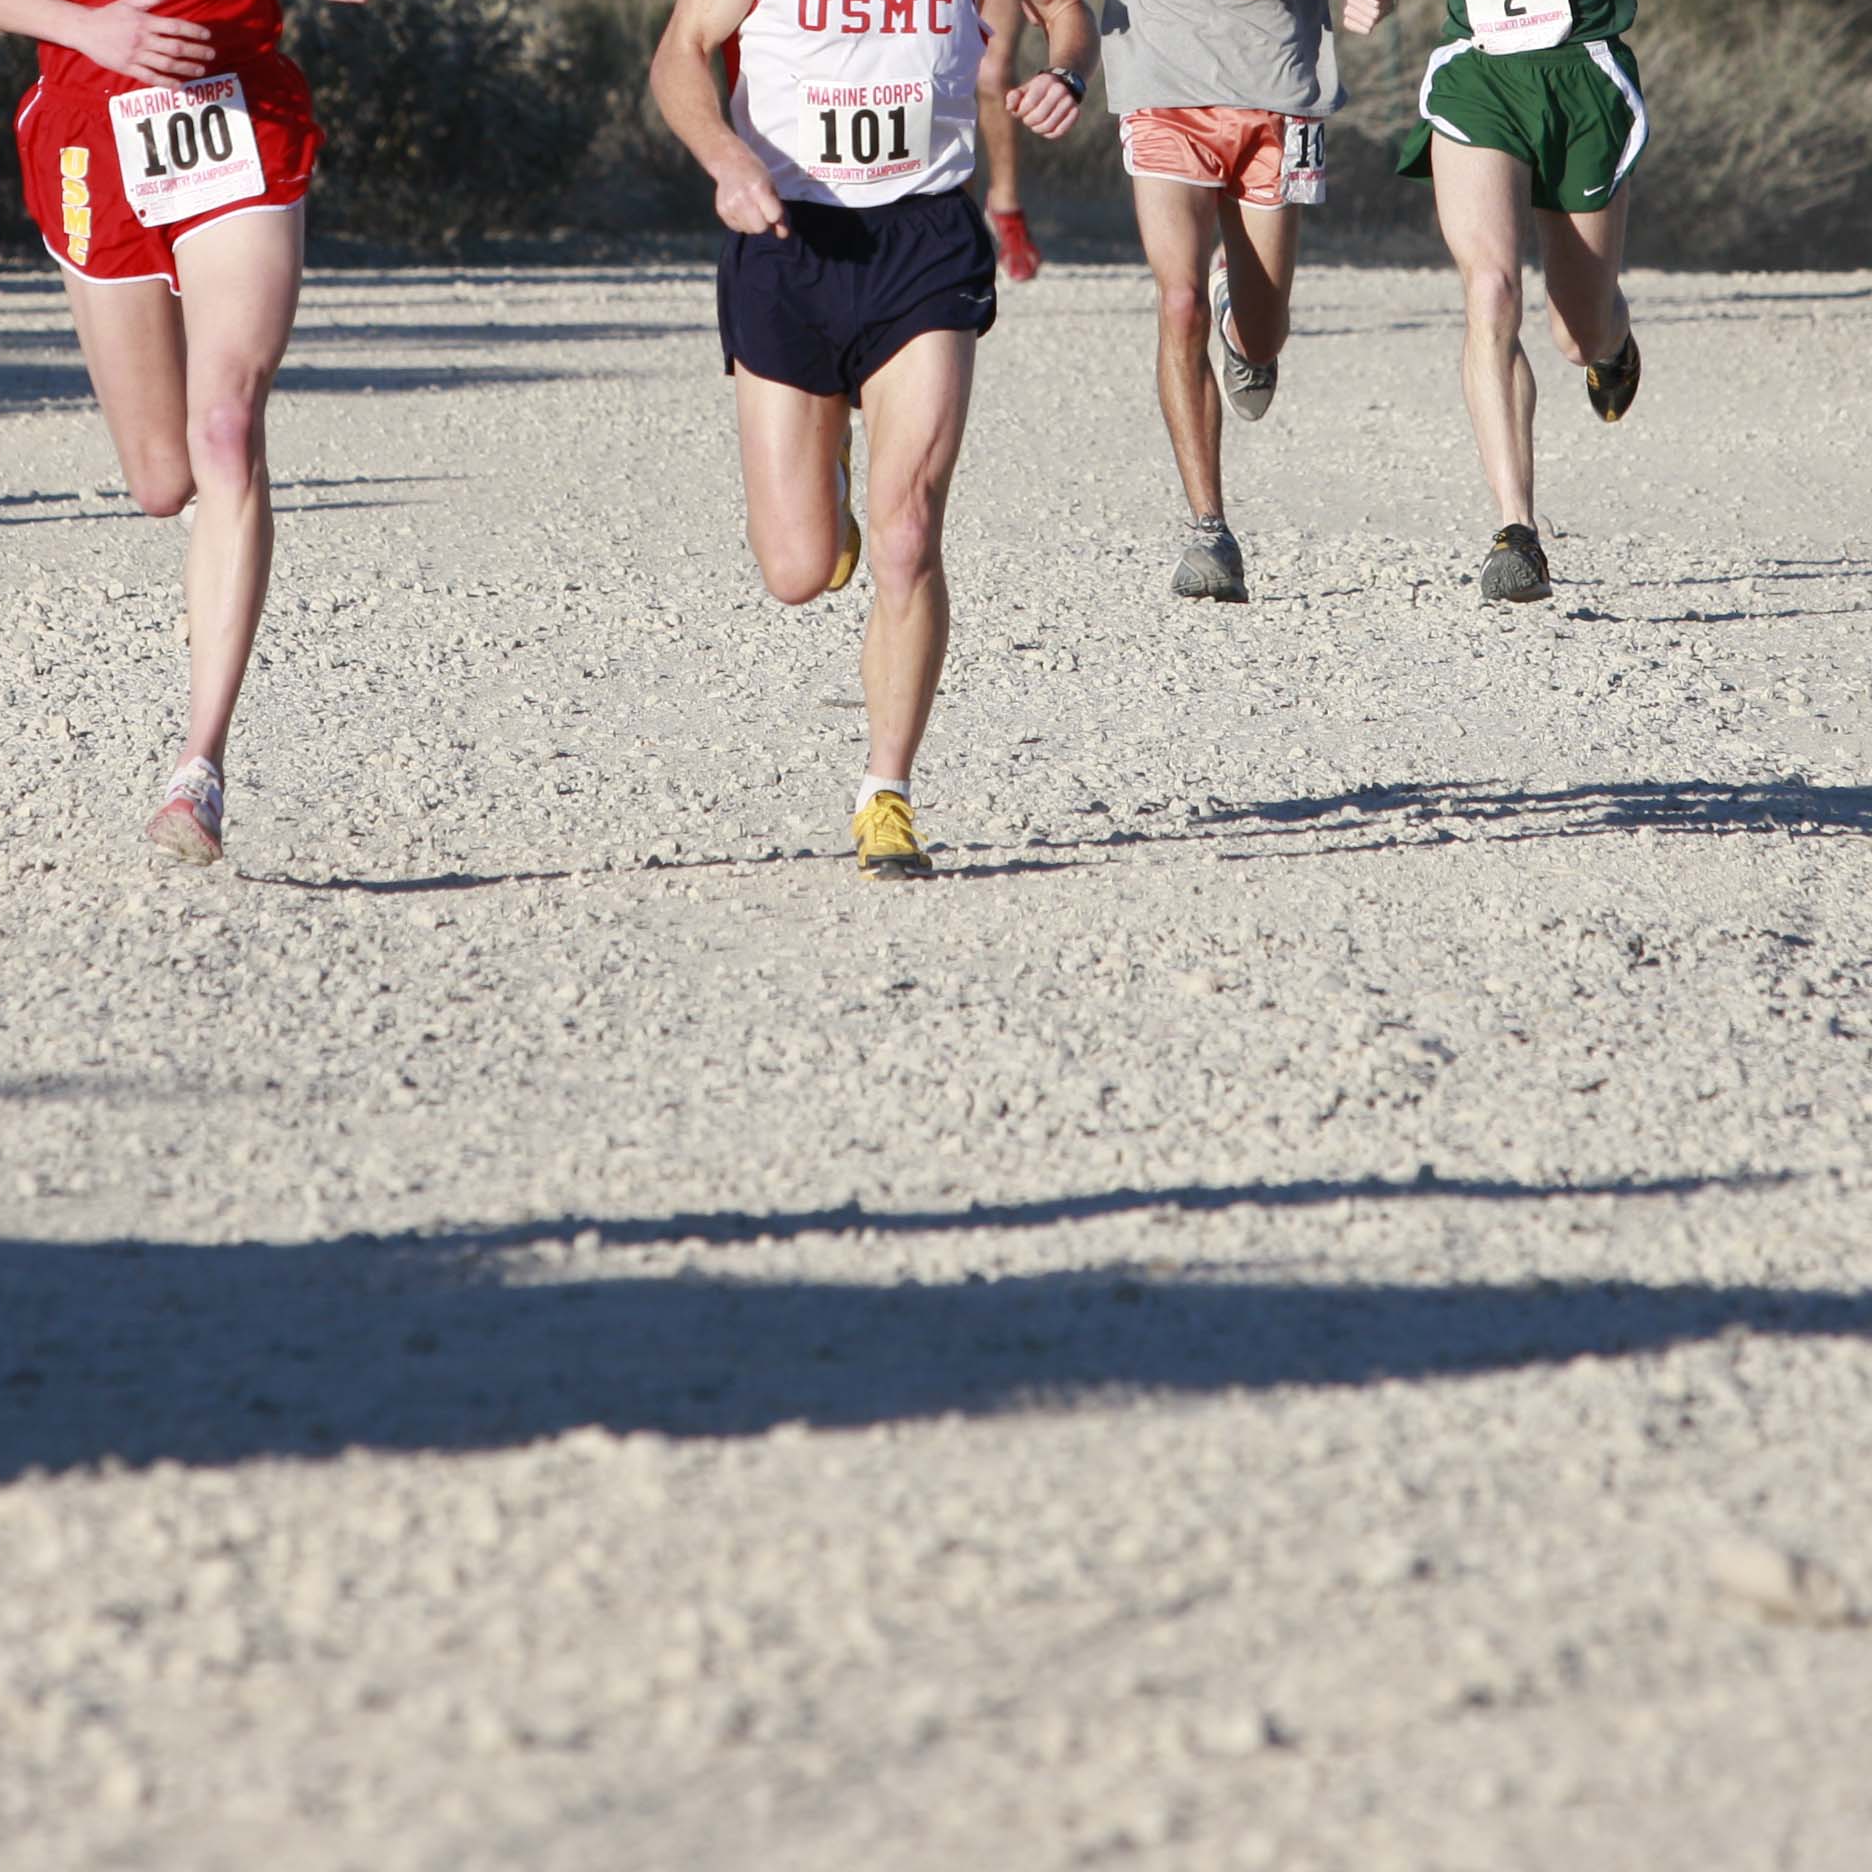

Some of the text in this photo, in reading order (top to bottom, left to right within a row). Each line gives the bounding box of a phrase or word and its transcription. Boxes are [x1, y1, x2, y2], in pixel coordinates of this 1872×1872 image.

[119, 80, 235, 119] MARINE CORPS
[807, 82, 924, 107] MARINE CORPS
[137, 105, 233, 177] 100
[820, 106, 910, 164] 101
[60, 146, 91, 266] USMC
